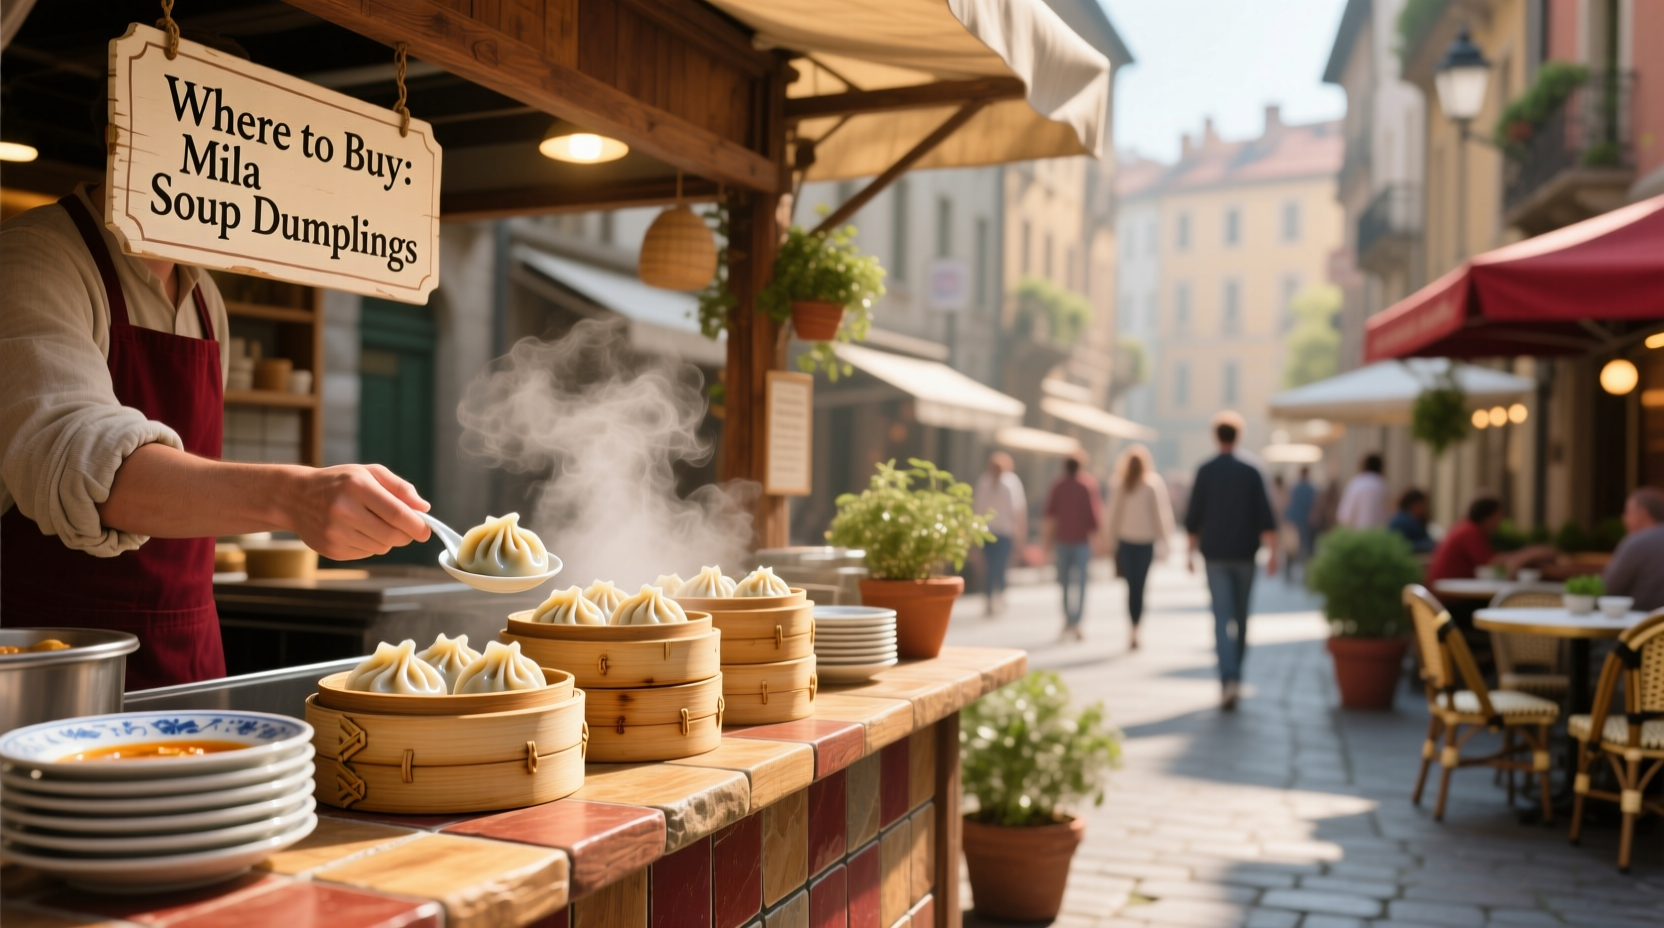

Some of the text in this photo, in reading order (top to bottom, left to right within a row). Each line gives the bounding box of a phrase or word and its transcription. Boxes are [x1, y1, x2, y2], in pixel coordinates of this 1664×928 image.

[163, 74, 412, 192] Where to Buy:
[179, 133, 262, 191] Mila
[150, 172, 418, 273] Soup Dumplings
